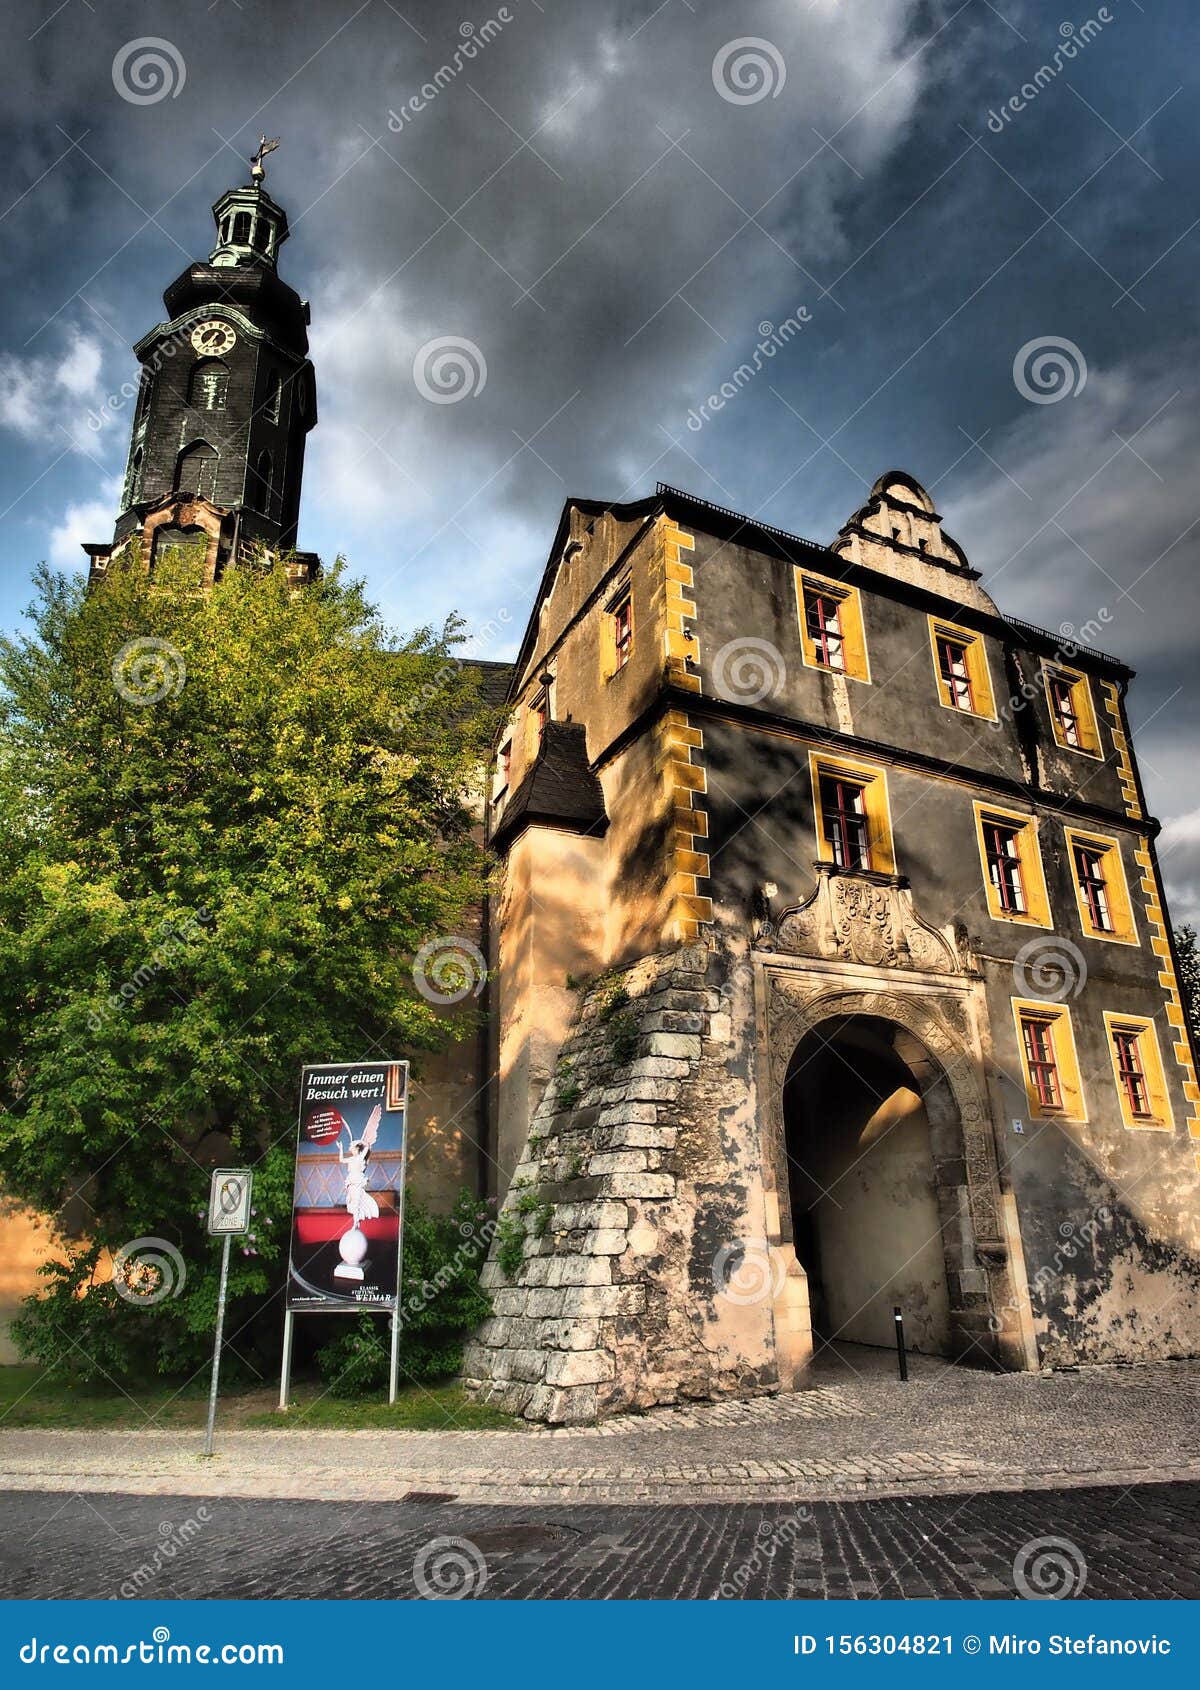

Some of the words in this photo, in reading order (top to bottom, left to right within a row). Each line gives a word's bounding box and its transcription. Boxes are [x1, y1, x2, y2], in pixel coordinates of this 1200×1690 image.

[307, 1073, 348, 1085] Immer
[351, 1071, 384, 1083] einen
[306, 1086, 348, 1100] Besuch
[355, 1294, 391, 1302] WEIMAR
